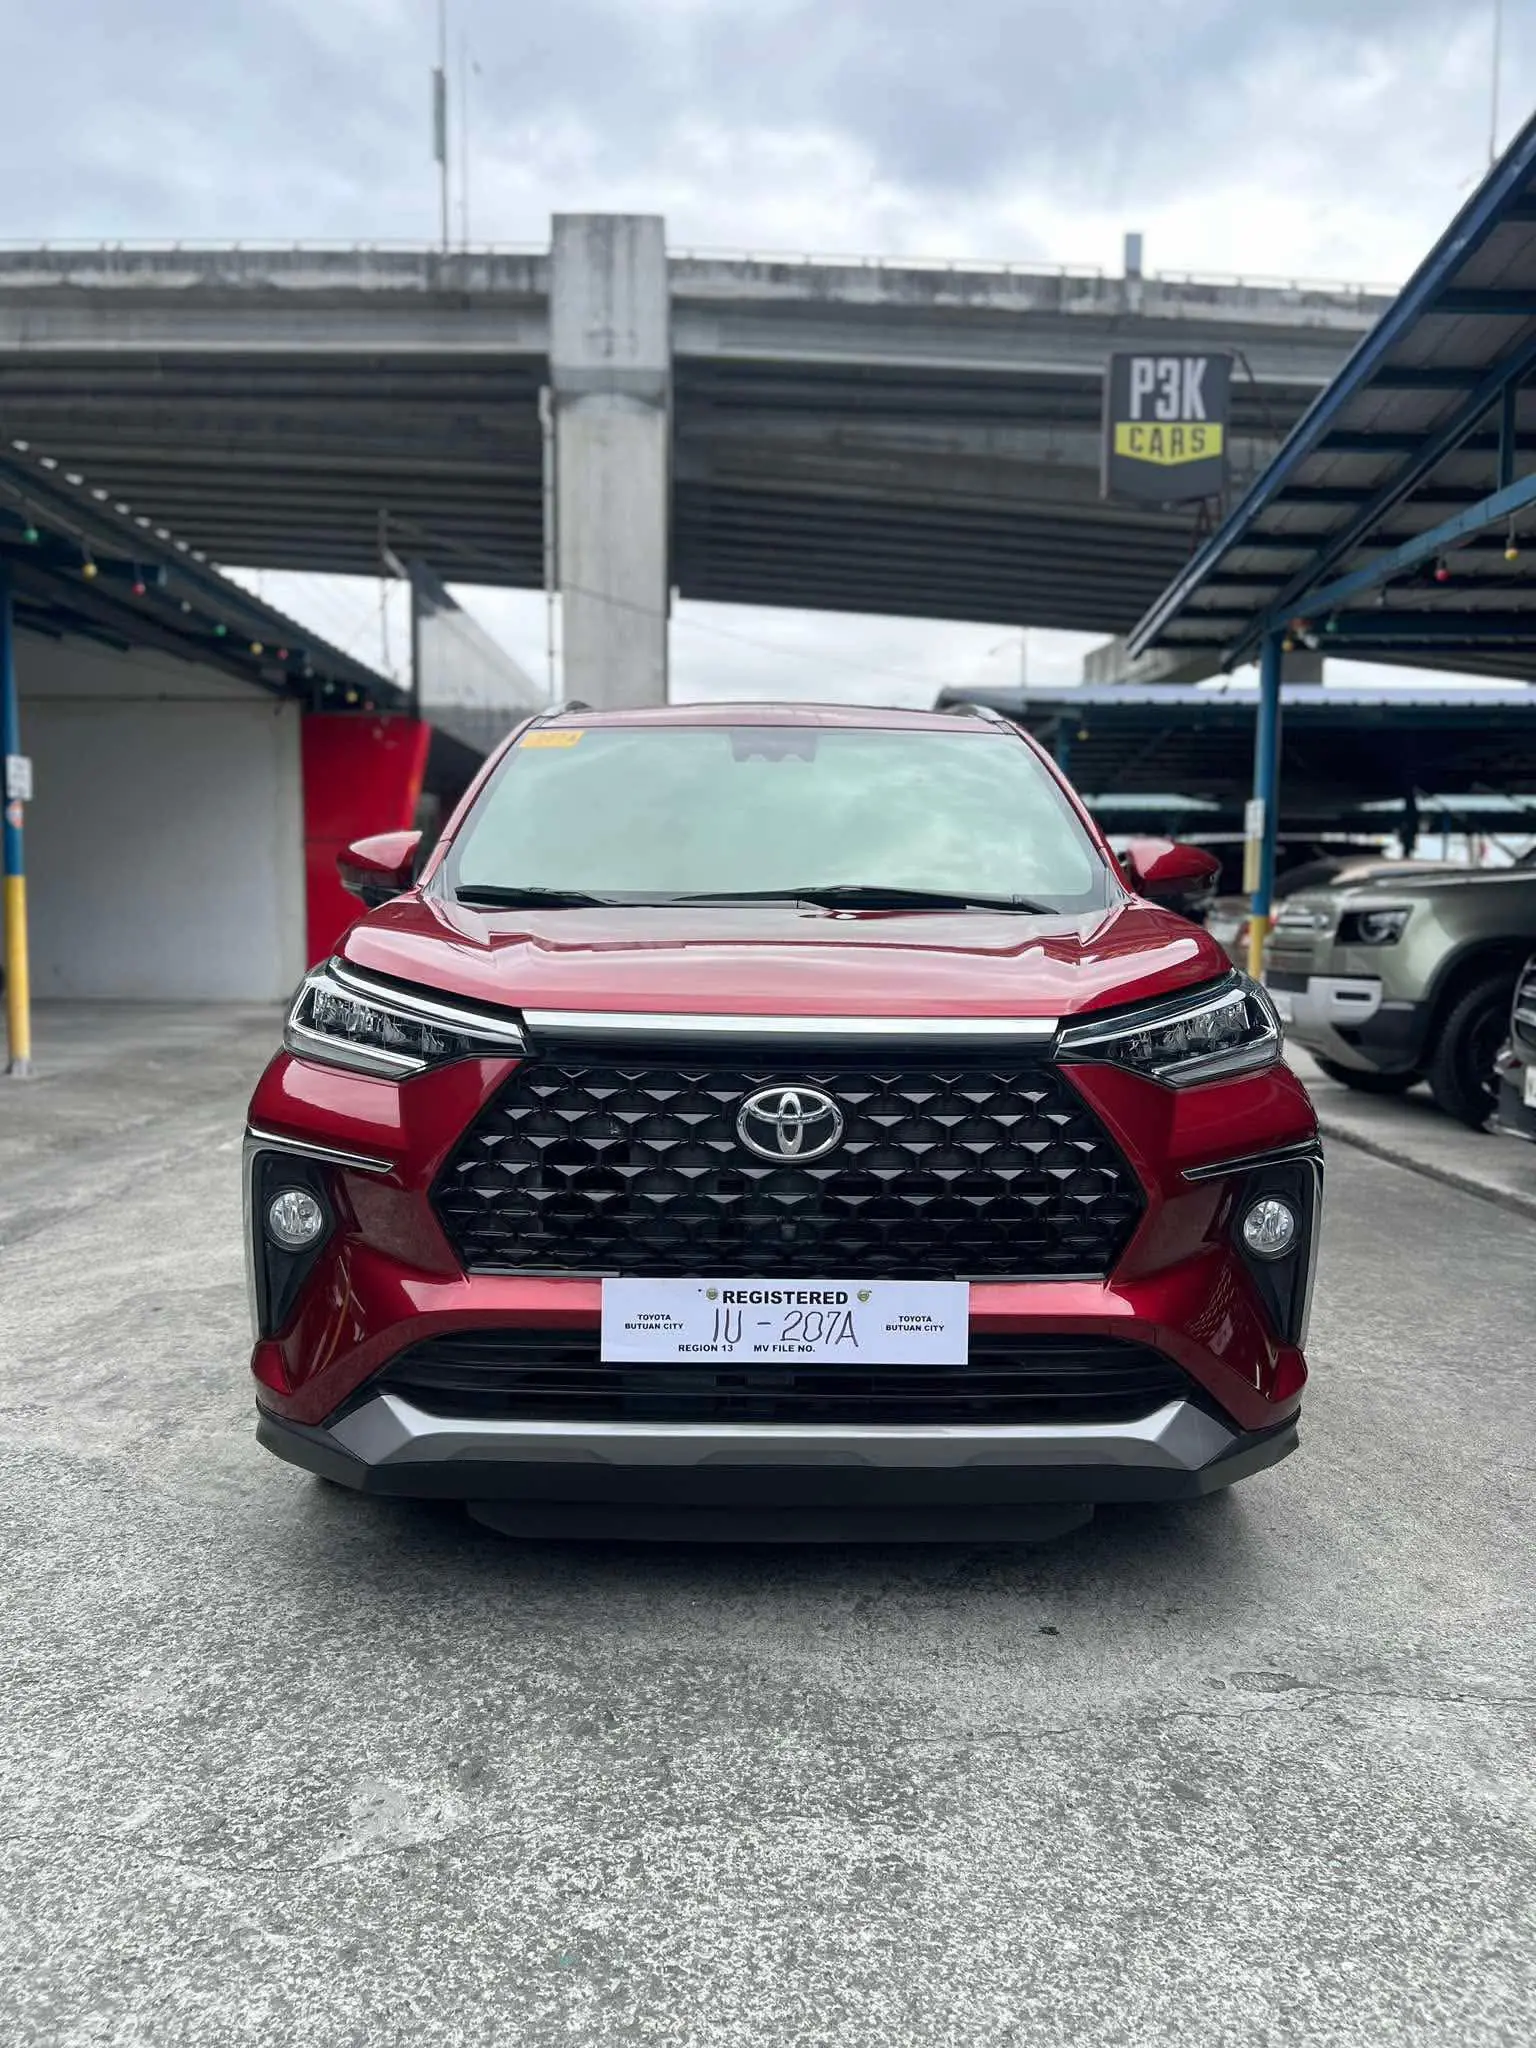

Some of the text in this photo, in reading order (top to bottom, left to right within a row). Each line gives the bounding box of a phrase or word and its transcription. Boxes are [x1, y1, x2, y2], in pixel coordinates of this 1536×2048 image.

[1130, 357, 1207, 420] P3K
[1129, 426, 1206, 458] CARS
[722, 1290, 848, 1305] REGISTERED
[637, 1313, 672, 1321] TOYOTA
[899, 1315, 932, 1323] TOYOTA
[624, 1322, 684, 1330] BUTUAN CITY
[780, 1310, 859, 1347] 207A
[885, 1324, 945, 1332] BUTUAN CITY
[678, 1343, 734, 1352] REGION 13
[753, 1344, 816, 1353] MV FILE NO.
